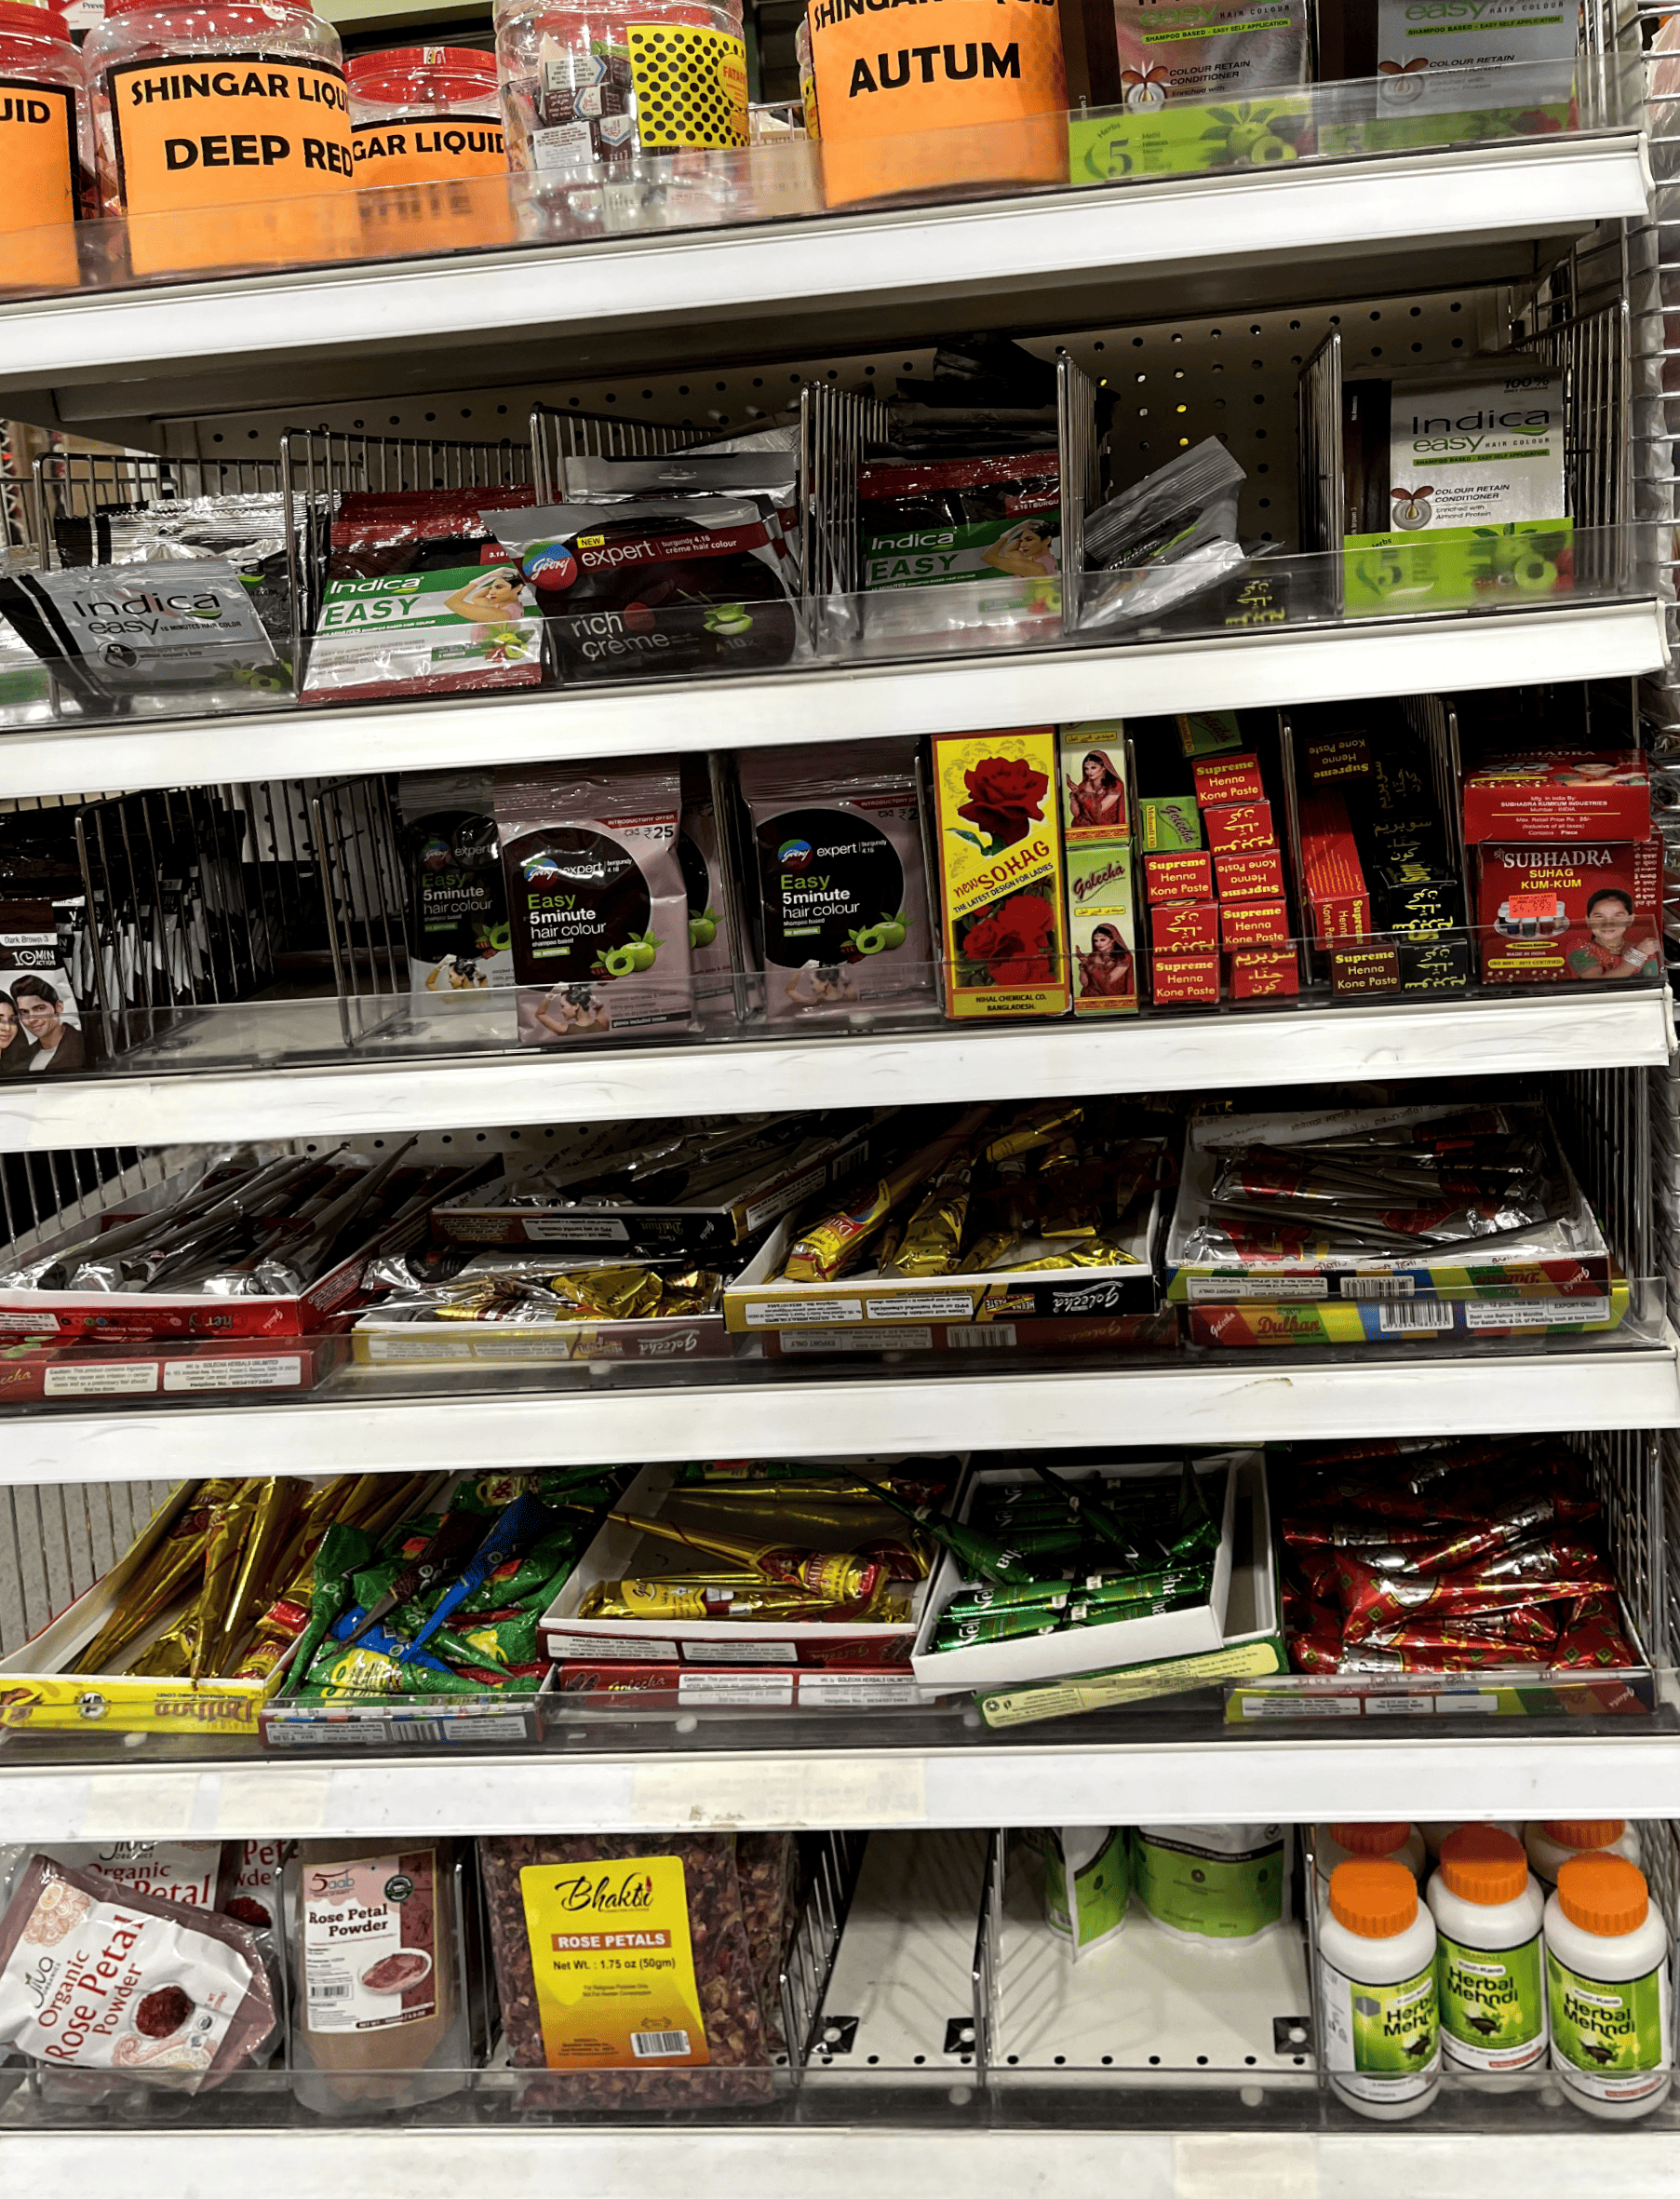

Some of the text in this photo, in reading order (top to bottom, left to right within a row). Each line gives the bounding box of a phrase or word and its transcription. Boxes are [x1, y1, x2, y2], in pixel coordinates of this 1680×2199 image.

[1140, 4, 1290, 27] easy HAIR COLOUR
[1405, 1, 1564, 20] easy HAIR COLOUR
[1146, 33, 1180, 43] SHAMPOO
[1182, 30, 1205, 39] BASED
[1247, 20, 1288, 30] APPLICATION
[1407, 27, 1445, 36] SHAMPOO
[1447, 23, 1472, 32] BASED
[1480, 20, 1497, 29] EASY
[1516, 17, 1561, 25] APPLICATION
[1169, 61, 1250, 77] COLOUR RETAIN
[1430, 55, 1514, 68] COLOUR RETAIN
[849, 42, 1021, 98] AUTUM
[1170, 71, 1239, 86] CONDITIONER
[131, 73, 290, 106] SHINGAR
[353, 134, 407, 161] GAR
[164, 134, 354, 178] DEEP RED
[1503, 376, 1550, 389] 100%
[1412, 410, 1550, 435] Indica
[1413, 435, 1485, 452] easy
[1510, 450, 1547, 458] APPLICATION
[1434, 492, 1499, 503] CONDITIONER
[1435, 484, 1510, 495] COLOUR RETAIN
[1436, 505, 1468, 514] Enriched
[581, 536, 601, 546] NEW
[665, 539, 737, 555] crème hair colour
[871, 531, 954, 550] Indica
[581, 540, 655, 568] expert
[531, 556, 570, 579] Godrej
[871, 553, 959, 582] EASY
[329, 578, 420, 595] Indica
[72, 592, 221, 617] Indica
[325, 596, 421, 627] EASY
[87, 618, 159, 636] easy
[169, 622, 200, 631] MINUTES
[201, 621, 218, 630] HAIR
[219, 620, 242, 628] COLOR
[571, 612, 623, 638] rich
[581, 633, 670, 661] crème
[1196, 762, 1254, 776] Supreme
[1209, 776, 1245, 787] Henna
[1200, 786, 1258, 801] Kone Paste
[653, 813, 675, 822] OFFER
[816, 843, 857, 858] expert
[1504, 849, 1613, 868] SUBHADRA
[607, 857, 633, 868] burgundy
[953, 841, 1049, 897] new SOHAG
[1149, 858, 1205, 870] Supreme
[1217, 859, 1276, 873] Kone Paste
[422, 872, 465, 888] Easy
[1073, 862, 1125, 899] Golecha
[1161, 873, 1196, 883] Henna
[1230, 873, 1267, 884] Henna
[1529, 869, 1574, 878] SUHAG
[781, 874, 831, 891] Easy
[953, 863, 1054, 913] THE LATEST DESIGN FOR LADIES
[1150, 884, 1209, 897] Kone Paste
[1221, 884, 1280, 897] Supreme
[1521, 880, 1581, 890] KUM-KUM
[423, 898, 493, 915] hair colour
[528, 892, 576, 911] Easy
[783, 901, 860, 919] hair colour
[1223, 908, 1282, 919] Supreme
[530, 921, 607, 940] hair colour
[1235, 922, 1271, 931] Henna
[1225, 933, 1284, 945] Kone Paste
[35, 951, 55, 961] MIN
[1335, 951, 1395, 965] Supreme
[1156, 962, 1214, 972] Supreme
[1348, 965, 1385, 975] Henna
[1167, 975, 1203, 984] Henna
[1337, 977, 1398, 989] Kone Paste
[975, 995, 998, 1004] NIHAL
[999, 994, 1034, 1003] CHEMICAL
[1157, 987, 1215, 997] Kone Paste
[987, 1003, 1037, 1012] BANGLADESH.
[1053, 1286, 1119, 1312] Golecha
[1257, 1316, 1320, 1334] Dulhan
[554, 1871, 654, 1912] Bhakti
[309, 1904, 388, 1923] Rose Petal
[329, 1921, 388, 1936] Powder
[558, 1933, 665, 1948] ROSE PETALS
[553, 1961, 571, 1971] Net
[573, 1960, 591, 1970] Wt.
[600, 1960, 622, 1969] 1.75
[639, 1957, 676, 1970] (50gm)
[1449, 1965, 1514, 1991] Herbal
[38, 1949, 89, 2027] Organic
[45, 1914, 144, 2062] Rose Petal
[1446, 1980, 1519, 2010] Mehndi
[92, 1963, 141, 2035] Powder
[1565, 1993, 1632, 2022] Herbal
[1564, 2007, 1636, 2041] Mehndi
